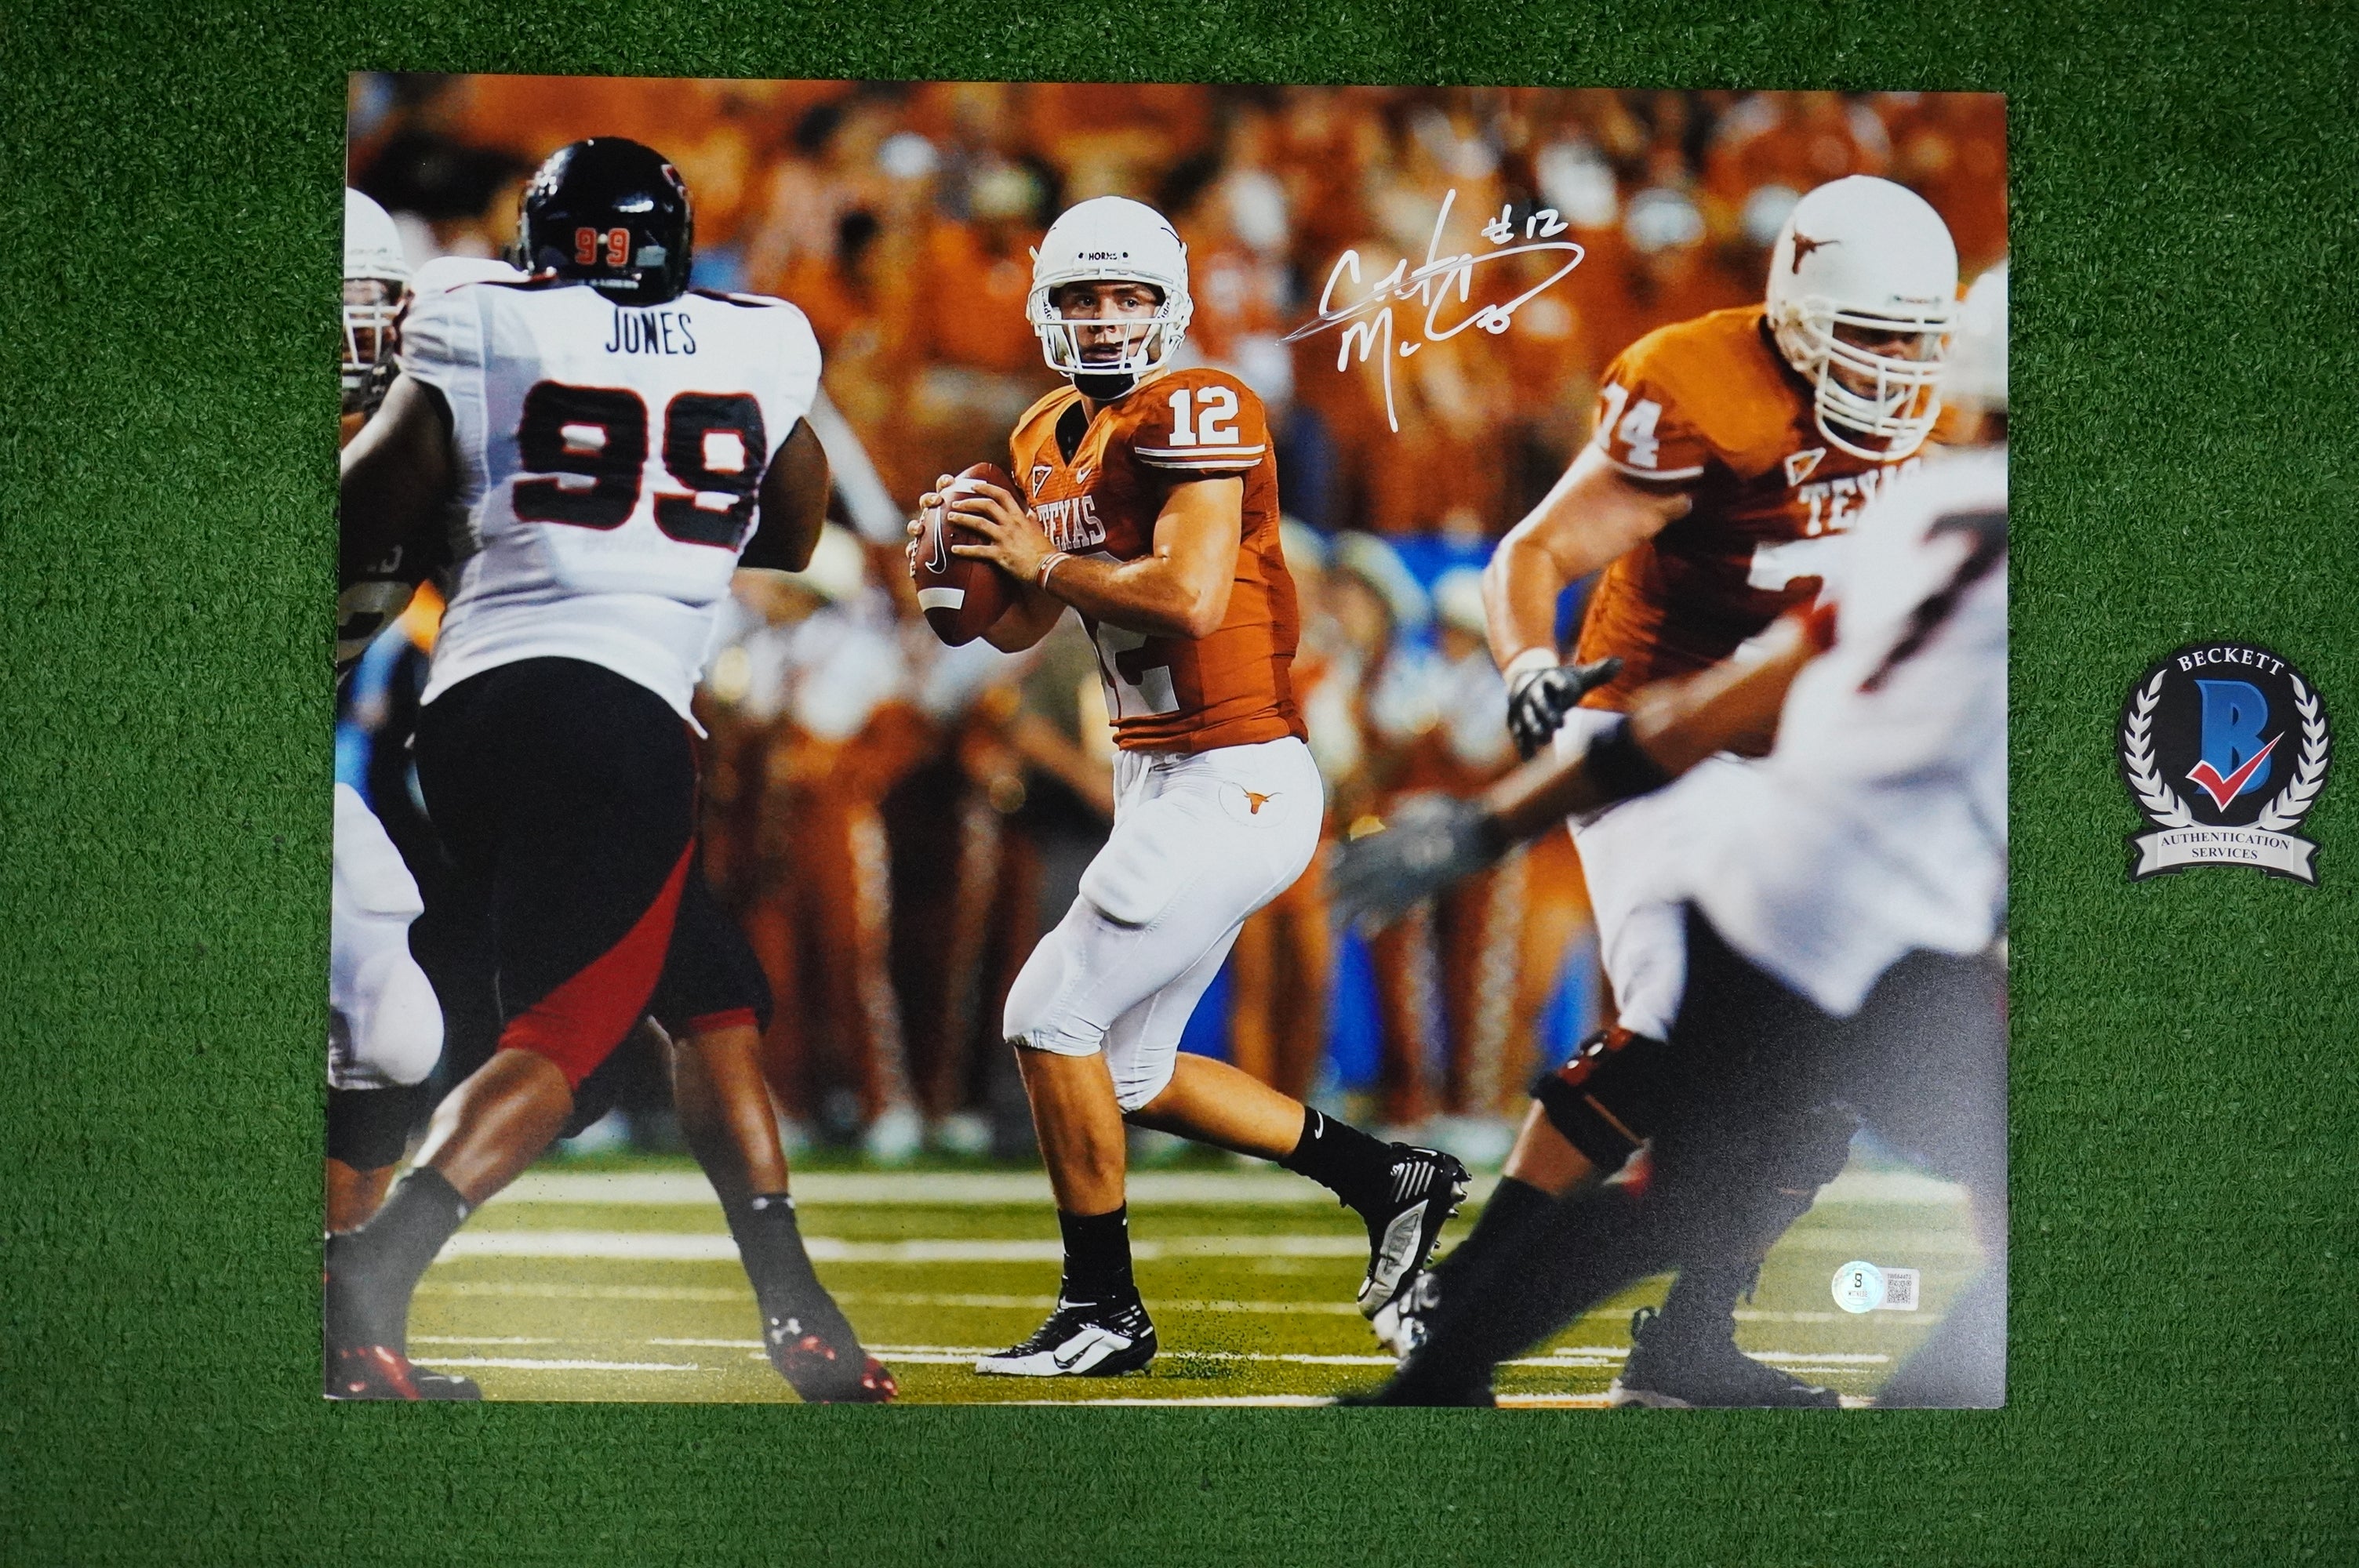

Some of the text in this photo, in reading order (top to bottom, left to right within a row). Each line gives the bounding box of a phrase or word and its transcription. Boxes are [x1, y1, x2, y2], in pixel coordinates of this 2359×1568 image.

[1481, 204, 1569, 245] #12
[575, 227, 631, 267] 99
[605, 307, 696, 354] JONES
[1169, 386, 1239, 447] 12
[512, 379, 767, 553] 99
[1036, 495, 1107, 552] TEXAS
[2177, 648, 2284, 676] BECKETT
[2161, 832, 2290, 851] AUTHENTICATION
[2192, 847, 2258, 860] SERVICES
